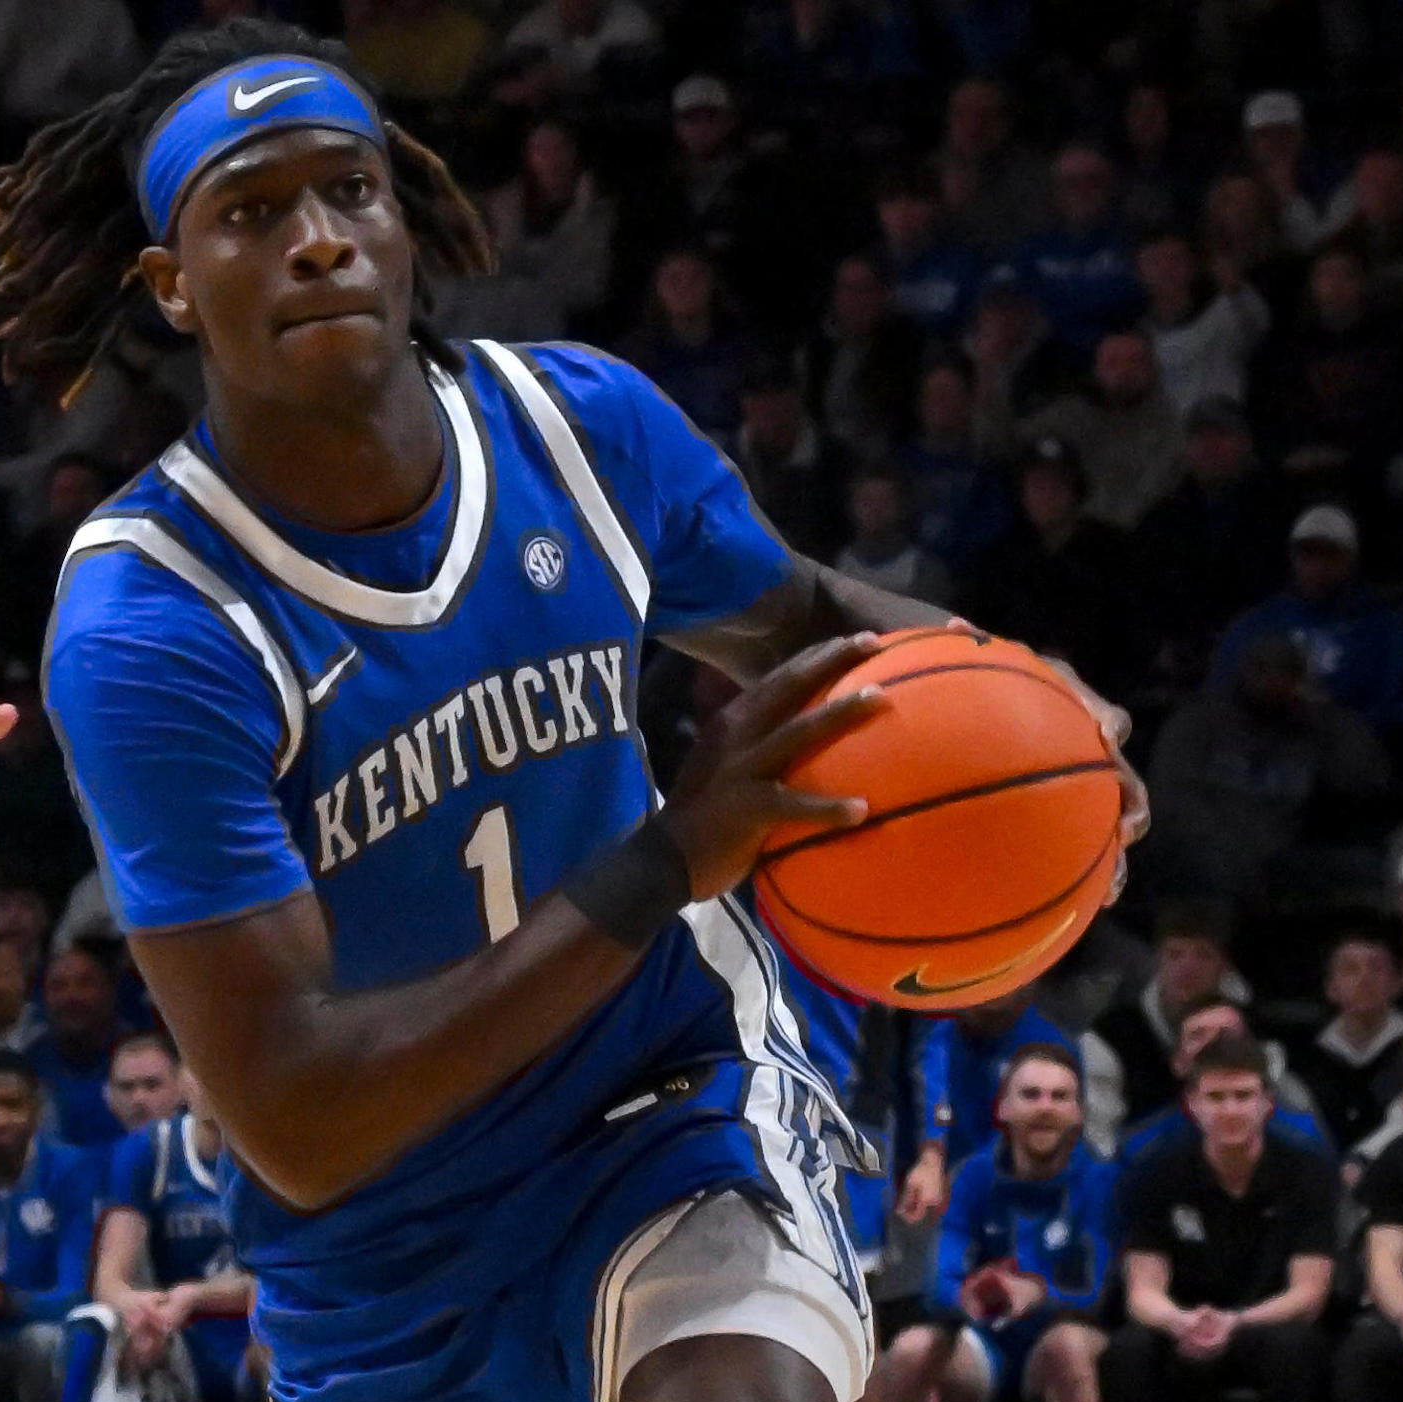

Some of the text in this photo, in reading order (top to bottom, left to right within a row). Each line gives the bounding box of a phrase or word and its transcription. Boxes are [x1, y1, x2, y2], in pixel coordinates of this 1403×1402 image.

[527, 540, 562, 586] SEC
[315, 646, 630, 874] KENTUCKY
[464, 805, 520, 945] 1
